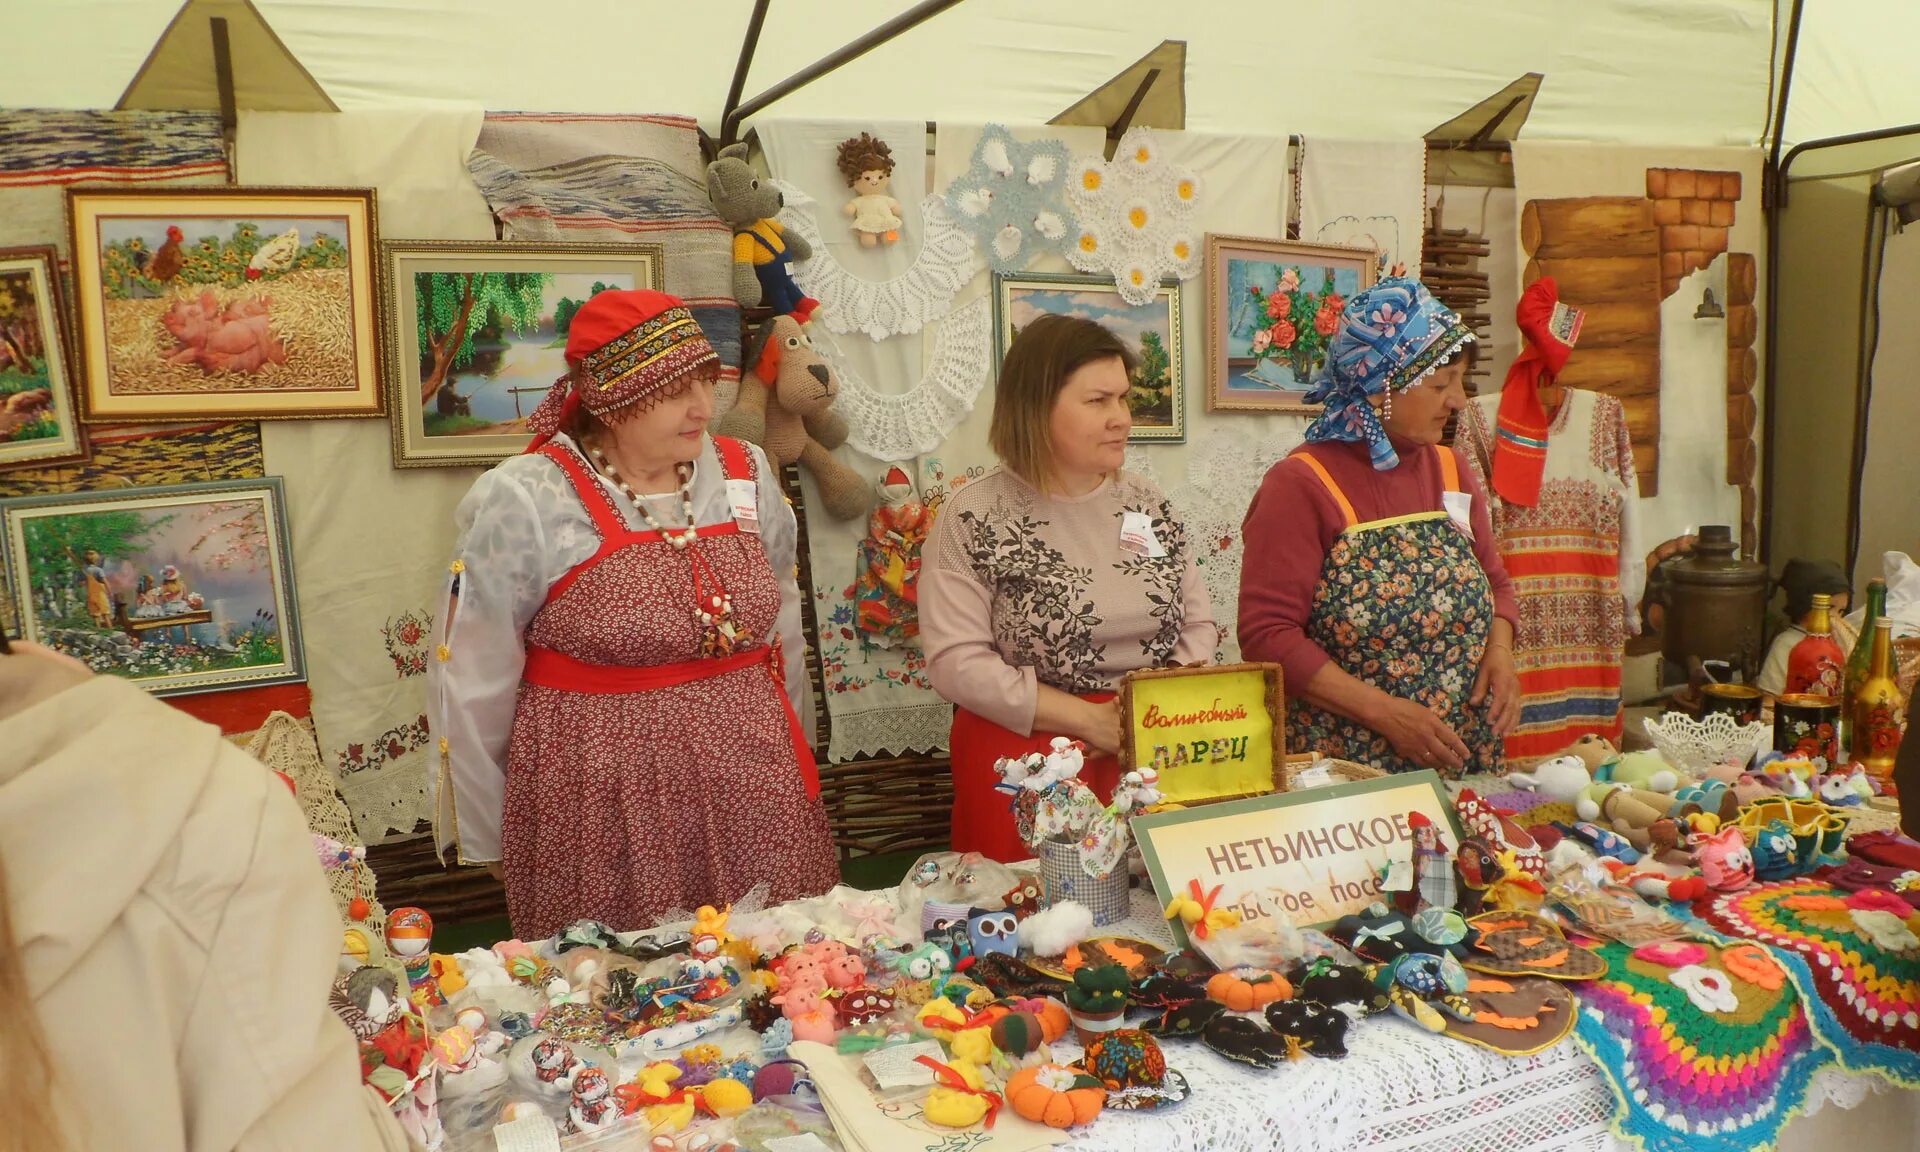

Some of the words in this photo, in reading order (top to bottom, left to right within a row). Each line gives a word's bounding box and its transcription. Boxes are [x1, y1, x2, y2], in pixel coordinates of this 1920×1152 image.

[1142, 698, 1247, 729] Волшебный
[1149, 736, 1249, 770] ЛАРЕЦ
[1206, 813, 1413, 875] НЕТЬИНСКОЕ
[1213, 891, 1315, 922] льсое
[1330, 876, 1385, 903] посе
